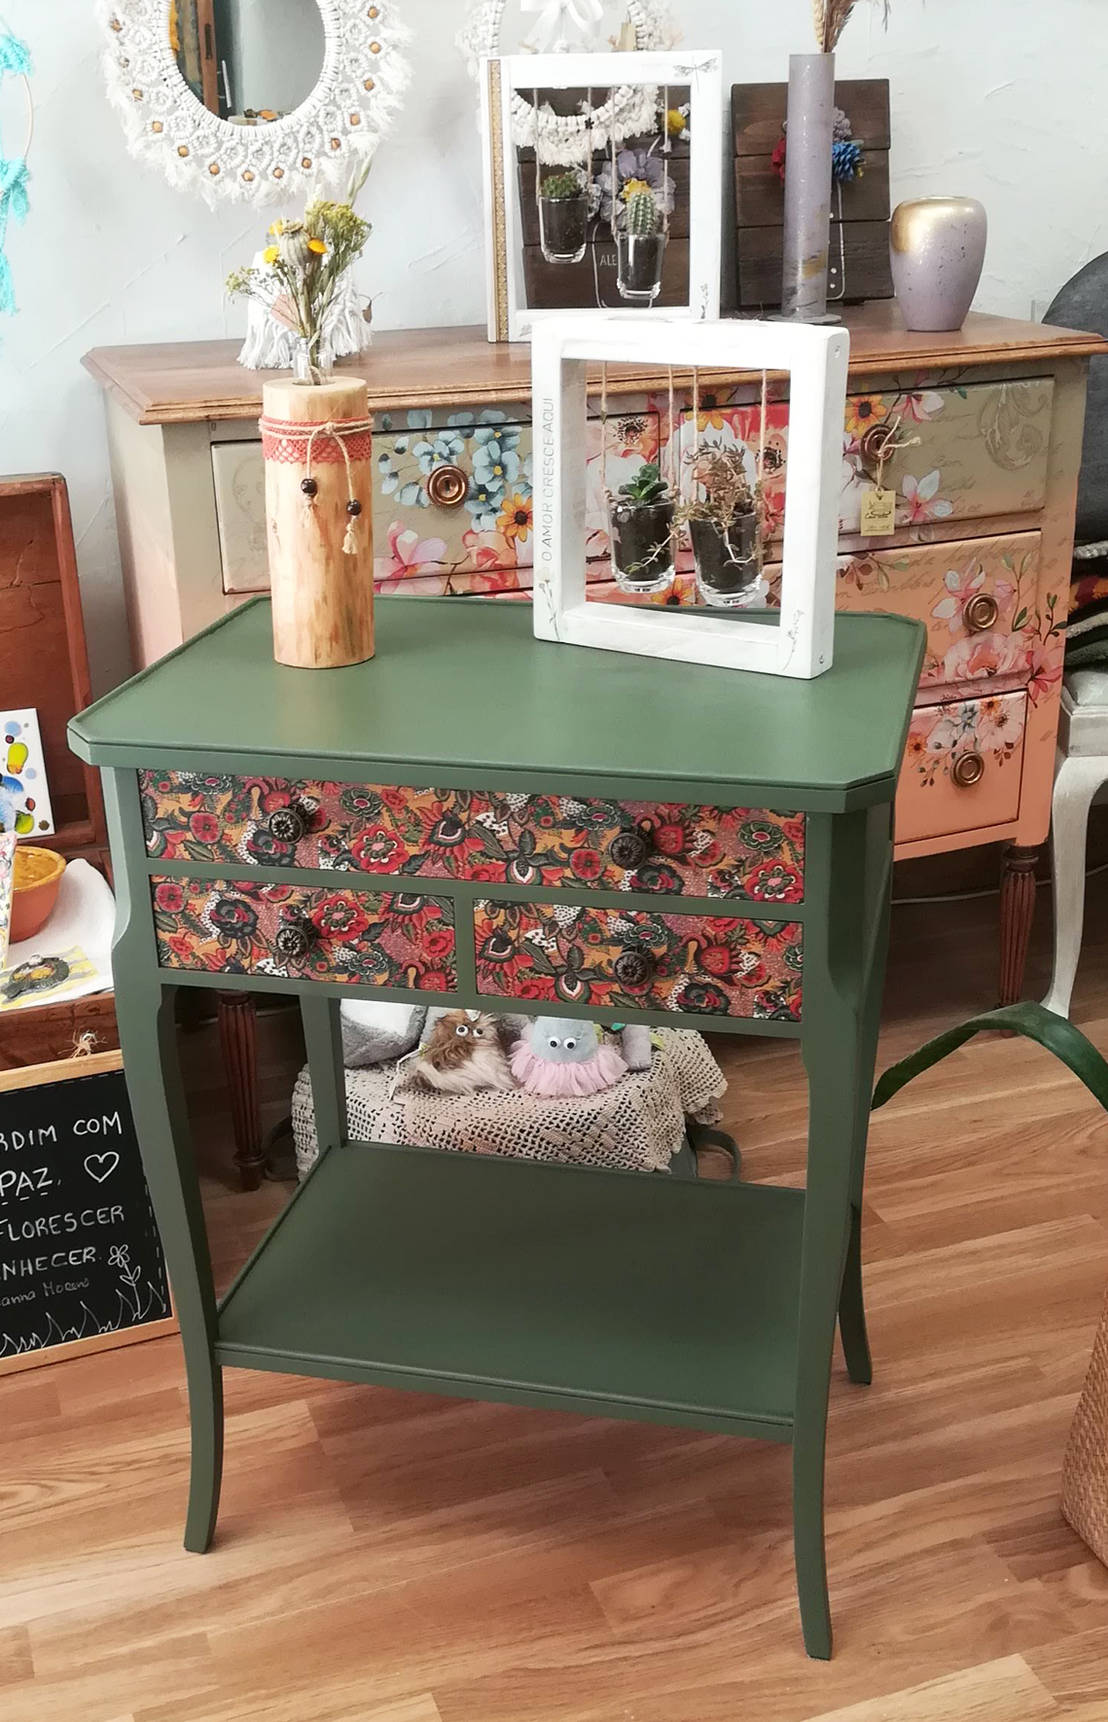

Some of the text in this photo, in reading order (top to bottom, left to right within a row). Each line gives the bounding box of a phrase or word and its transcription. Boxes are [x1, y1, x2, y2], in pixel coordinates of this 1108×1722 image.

[541, 398, 555, 562] O AMOR CRESCE AQUI
[73, 1111, 122, 1136] COM
